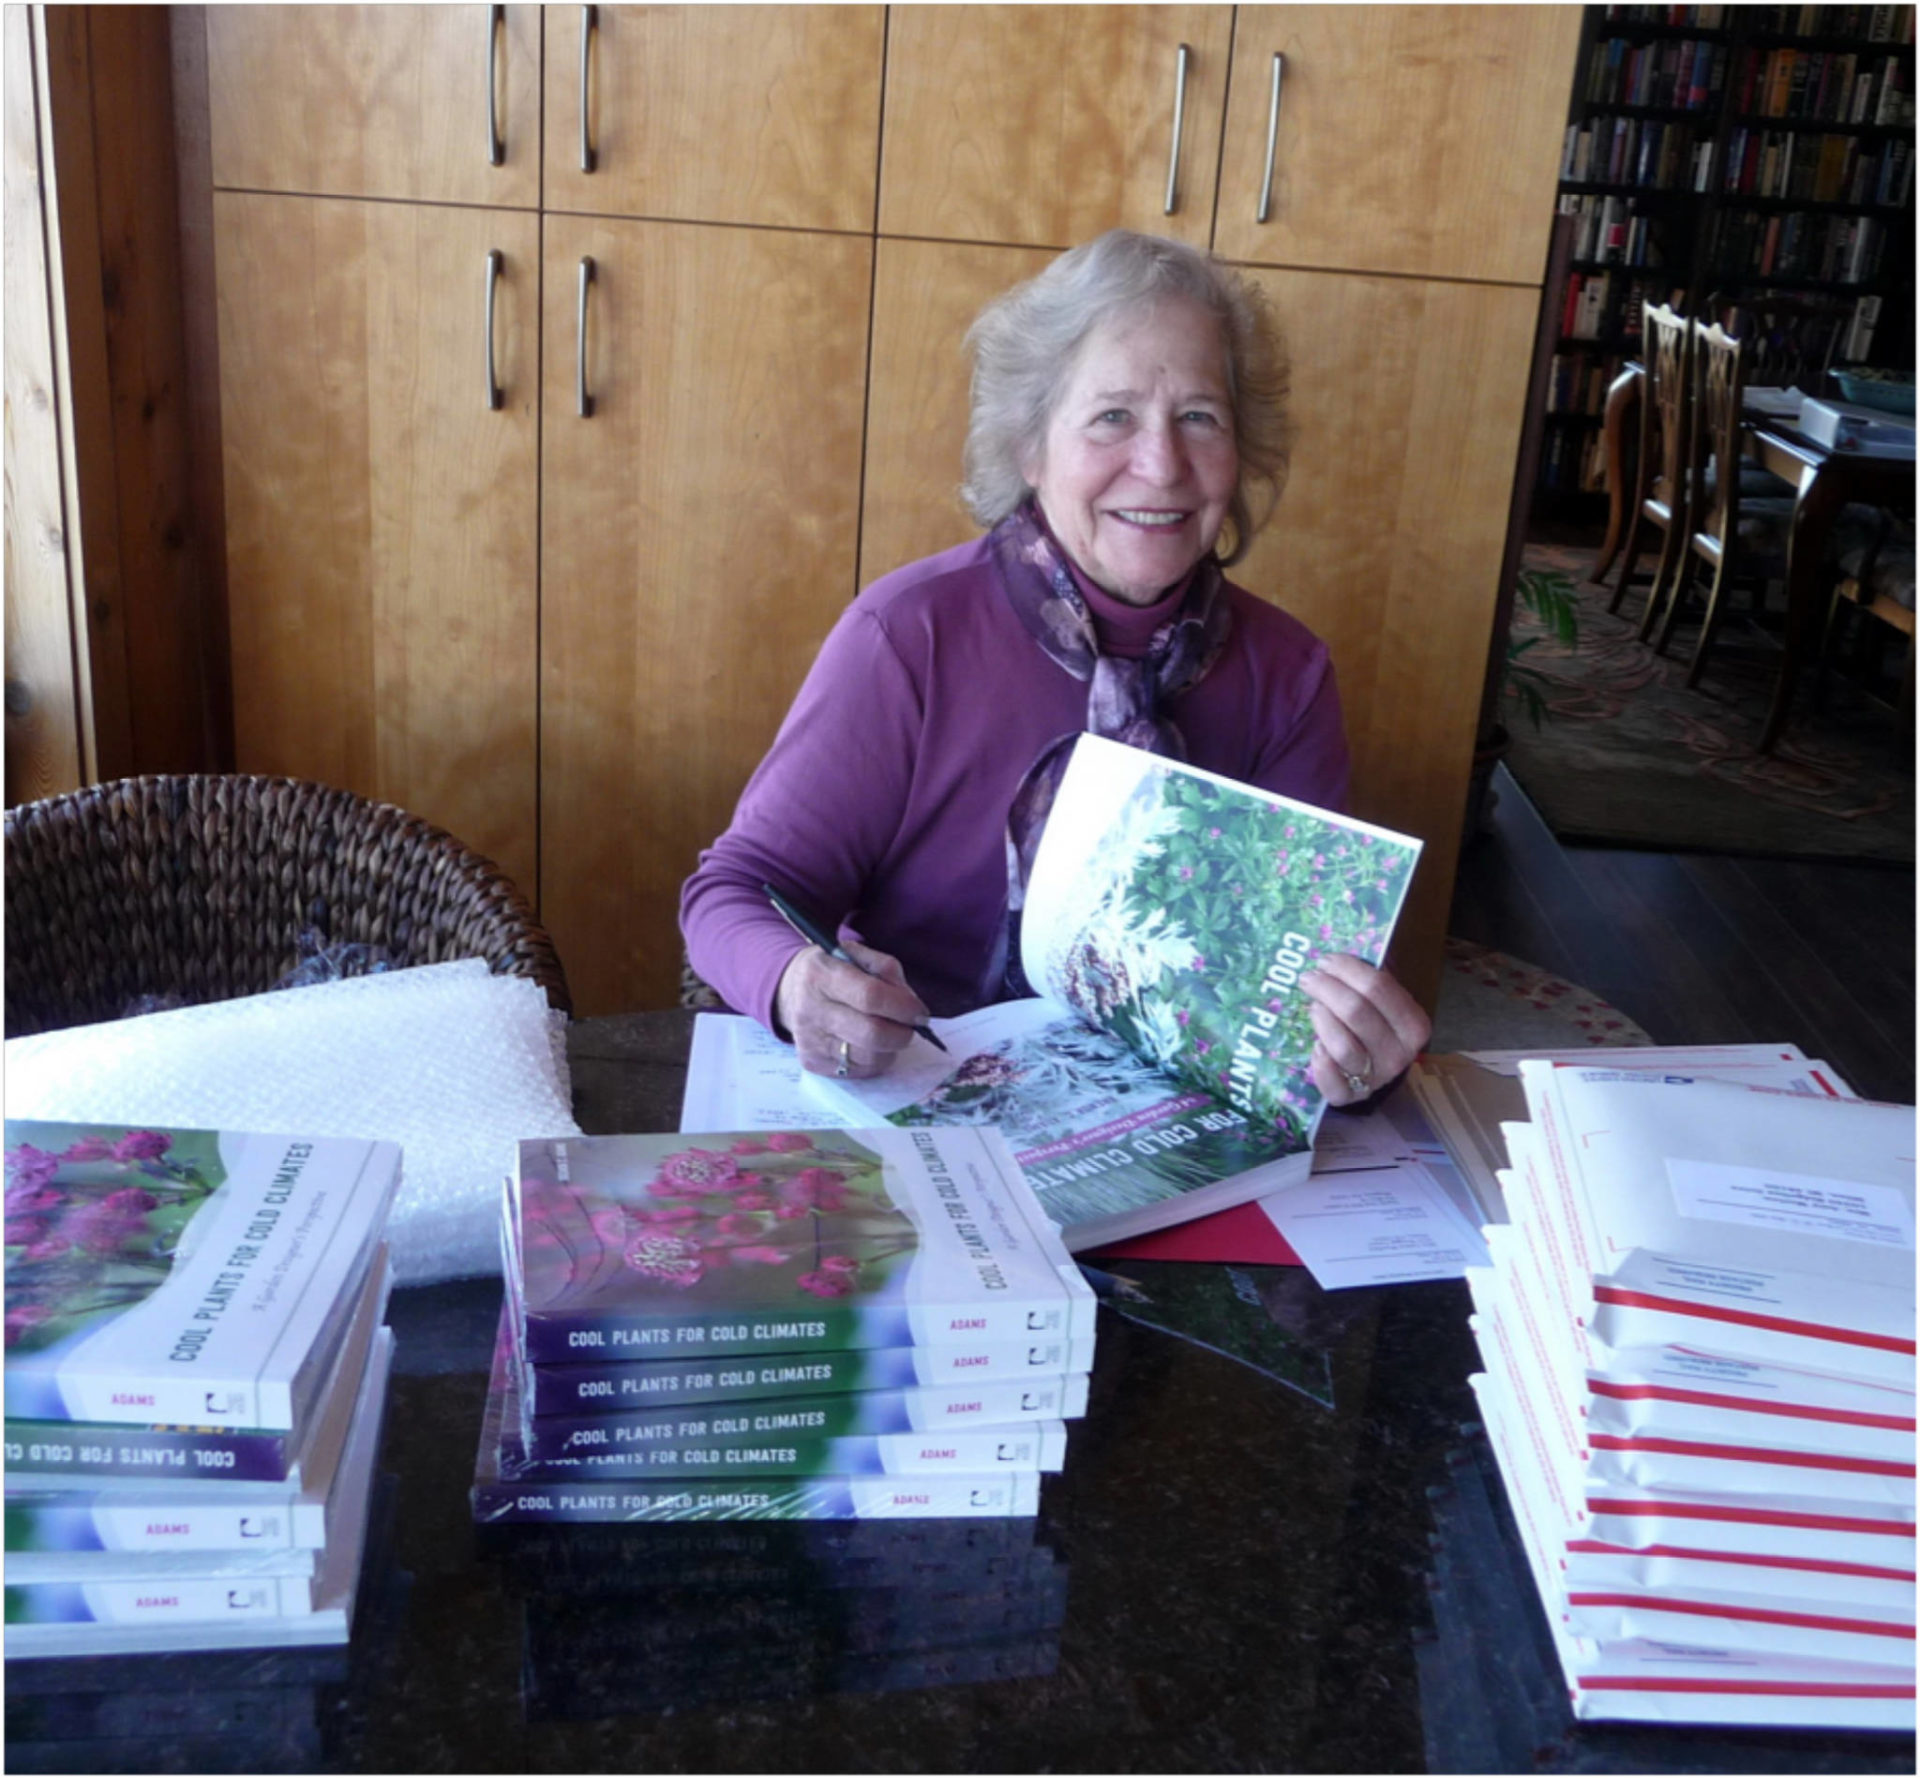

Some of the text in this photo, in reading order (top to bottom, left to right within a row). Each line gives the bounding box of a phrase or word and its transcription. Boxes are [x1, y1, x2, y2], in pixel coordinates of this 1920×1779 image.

[1025, 931, 1311, 1191] COOL PLANTS FOR COLD CLIMATE
[910, 1131, 948, 1174] CLIMATES
[931, 1175, 960, 1199] COLD
[944, 1202, 972, 1220] FOR
[955, 1222, 993, 1260] PLANTS
[169, 1141, 314, 1362] COOL PLANTS FOR COLD CLIMATES
[976, 1262, 1008, 1290] COOL
[949, 1319, 986, 1331] ADAMS
[569, 1322, 826, 1347] COOL PLANTS FOR COLD CLIMATES
[952, 1356, 989, 1368] ADAMS
[578, 1364, 832, 1397] COOL PLANTS FOR COLD CLIMATES
[111, 1393, 156, 1407] ADAMS
[946, 1402, 982, 1414] ADAMS
[572, 1411, 826, 1446] COOL PLANTS FOR COLD CLIMATES
[29, 1443, 73, 1462] COLD
[80, 1446, 113, 1464] FOR
[120, 1447, 186, 1466] PLANTS
[193, 1449, 235, 1467] COOL
[650, 1449, 678, 1464] FOR
[683, 1449, 720, 1464] COLD
[725, 1448, 797, 1464] CLIMATES
[920, 1448, 957, 1460] ADAMS
[517, 1496, 553, 1510] COOL
[558, 1495, 616, 1510] PLANTS
[622, 1495, 650, 1510] FOR
[697, 1493, 770, 1509] CLIMATES
[146, 1523, 190, 1535] ADAMS
[136, 1596, 179, 1608] ADAMS
